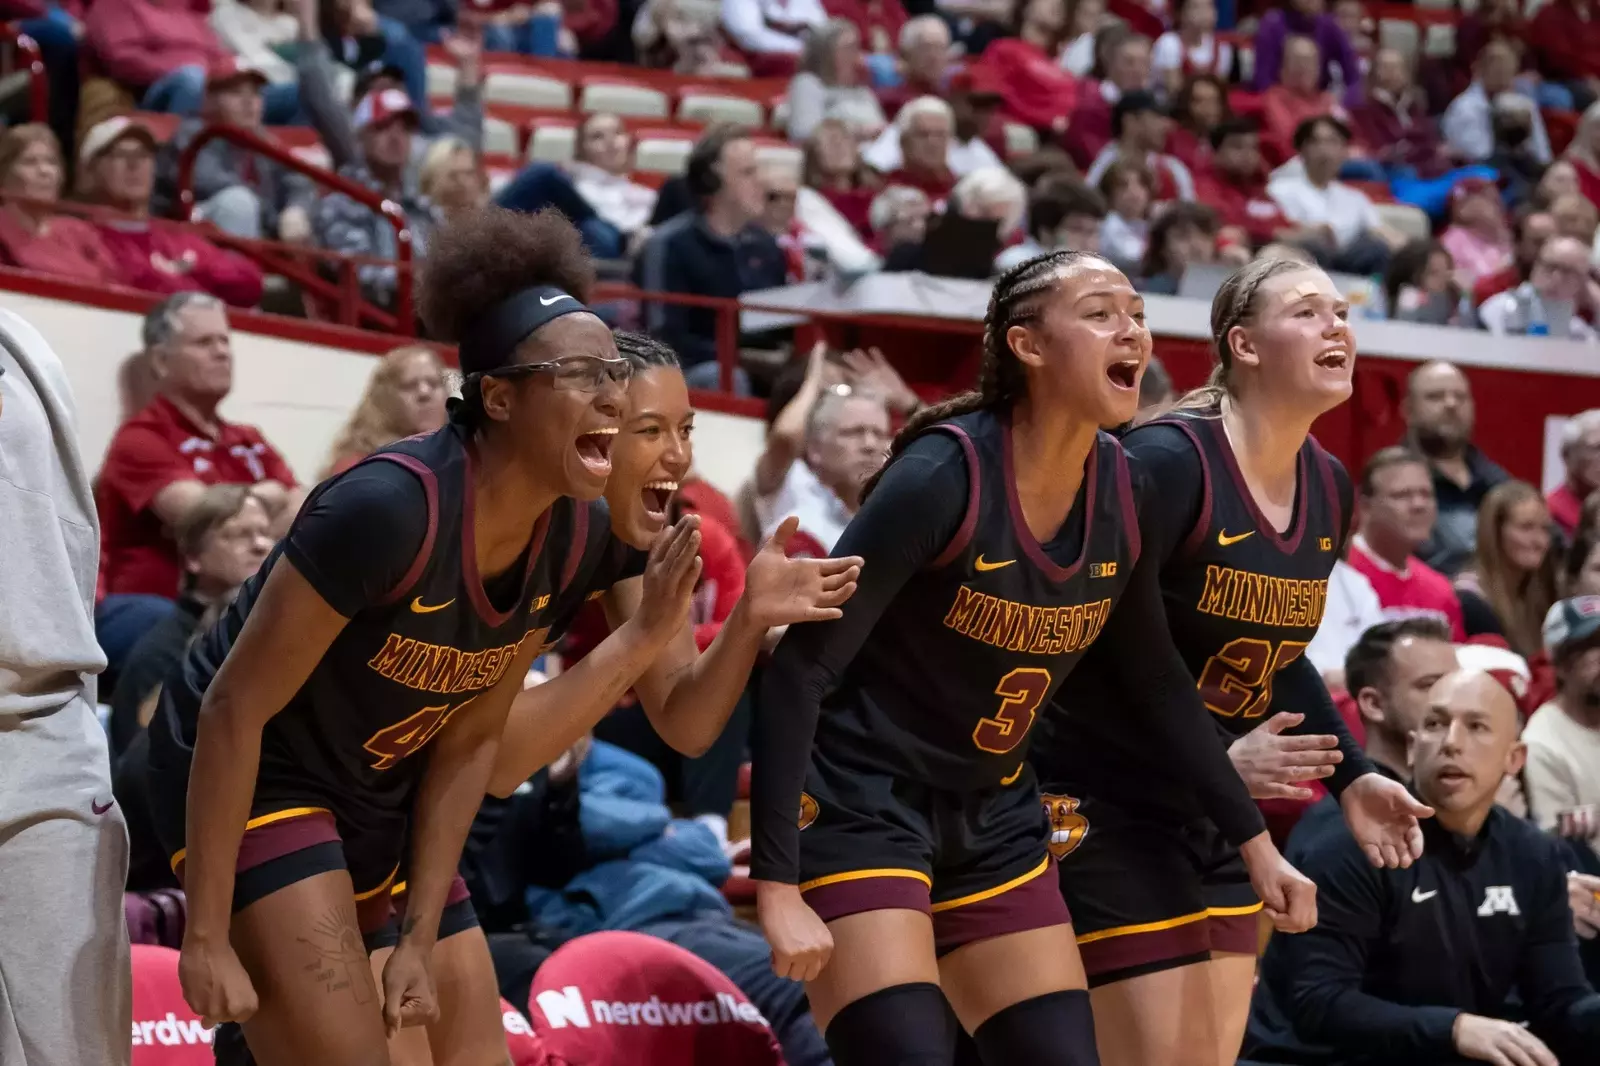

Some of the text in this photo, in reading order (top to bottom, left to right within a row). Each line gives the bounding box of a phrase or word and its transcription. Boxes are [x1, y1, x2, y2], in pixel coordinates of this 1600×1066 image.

[363, 696, 478, 771] 4
[972, 668, 1051, 754] 3
[1477, 886, 1521, 916] M
[591, 992, 771, 1027] nerdwalle
